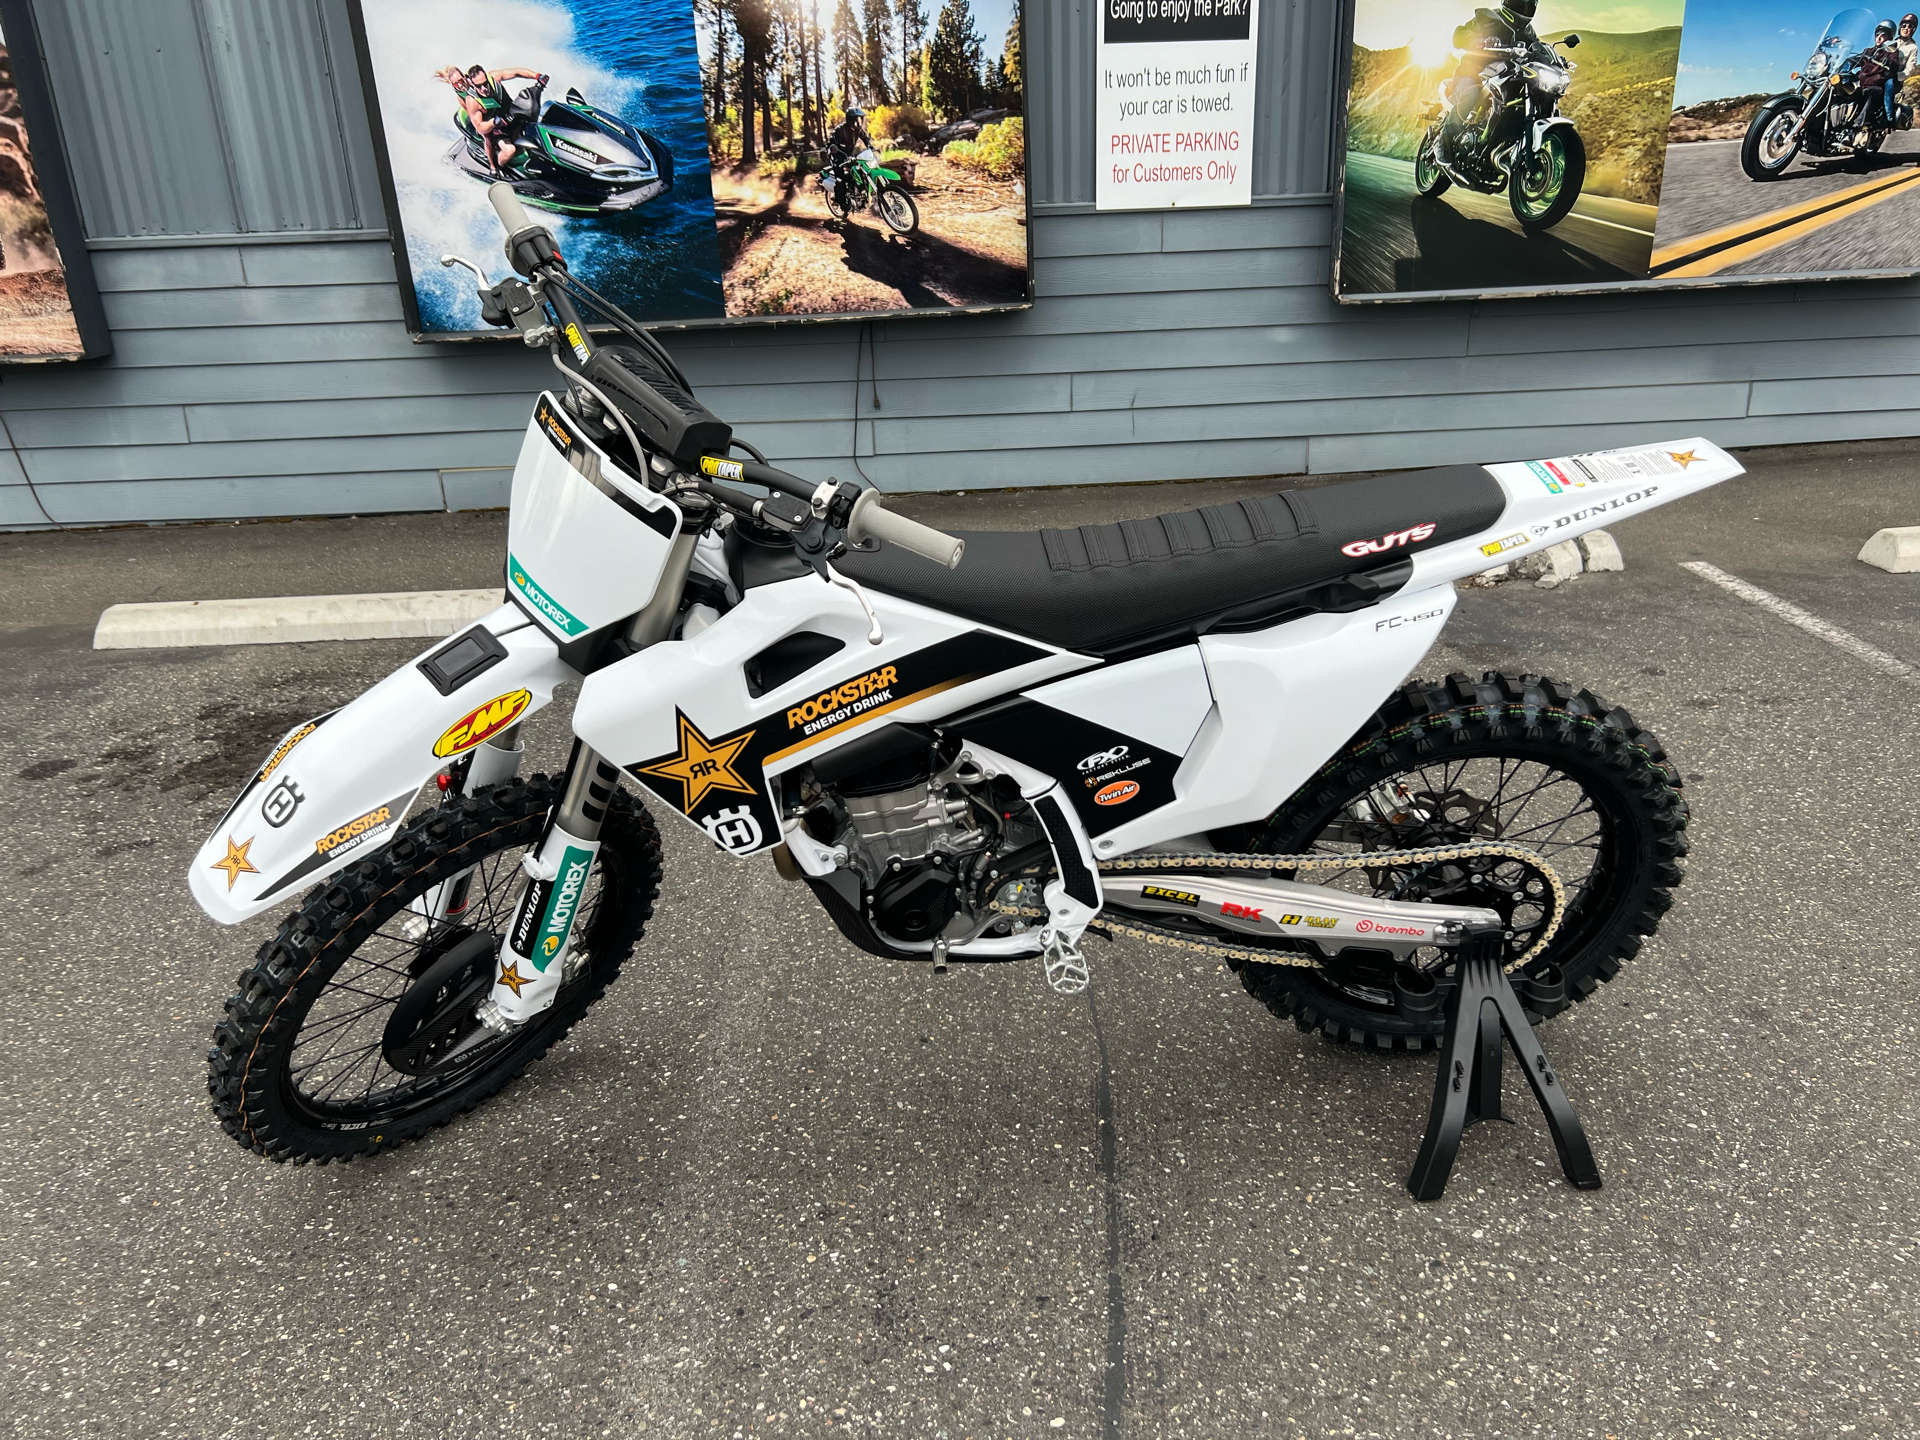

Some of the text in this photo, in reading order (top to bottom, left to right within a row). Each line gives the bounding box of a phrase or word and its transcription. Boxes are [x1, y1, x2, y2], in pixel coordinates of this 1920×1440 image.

[1110, 0, 1248, 24] Going to enjoy the Park?
[1104, 62, 1249, 89] It won't be much fun if
[1119, 92, 1233, 121] your car is towed.
[555, 138, 598, 164] Kawasaki
[1111, 131, 1239, 154] PRIVATE PARKING
[1112, 160, 1237, 185] for Customers Only
[1553, 486, 1658, 529] DUNLOP
[1341, 523, 1436, 557] GUTS
[524, 582, 571, 630] MOTOREX
[787, 665, 898, 730] ROCKSTAR
[803, 689, 893, 735] ENERGY DRINK
[439, 687, 527, 759] FMF
[260, 723, 316, 782] ROCKSTAR
[1096, 757, 1152, 782] REKLUSE
[1369, 771, 1408, 791] EXCEL
[1098, 784, 1137, 803] Twin Air
[316, 807, 391, 855] ROCKSTAR
[328, 822, 389, 858] ENERGY DRINK
[547, 860, 588, 932] MOTOREX
[1144, 886, 1198, 902] EXCEL
[518, 882, 542, 941] DUNLOP
[1220, 902, 1265, 920] RK
[1375, 923, 1425, 936] brembo
